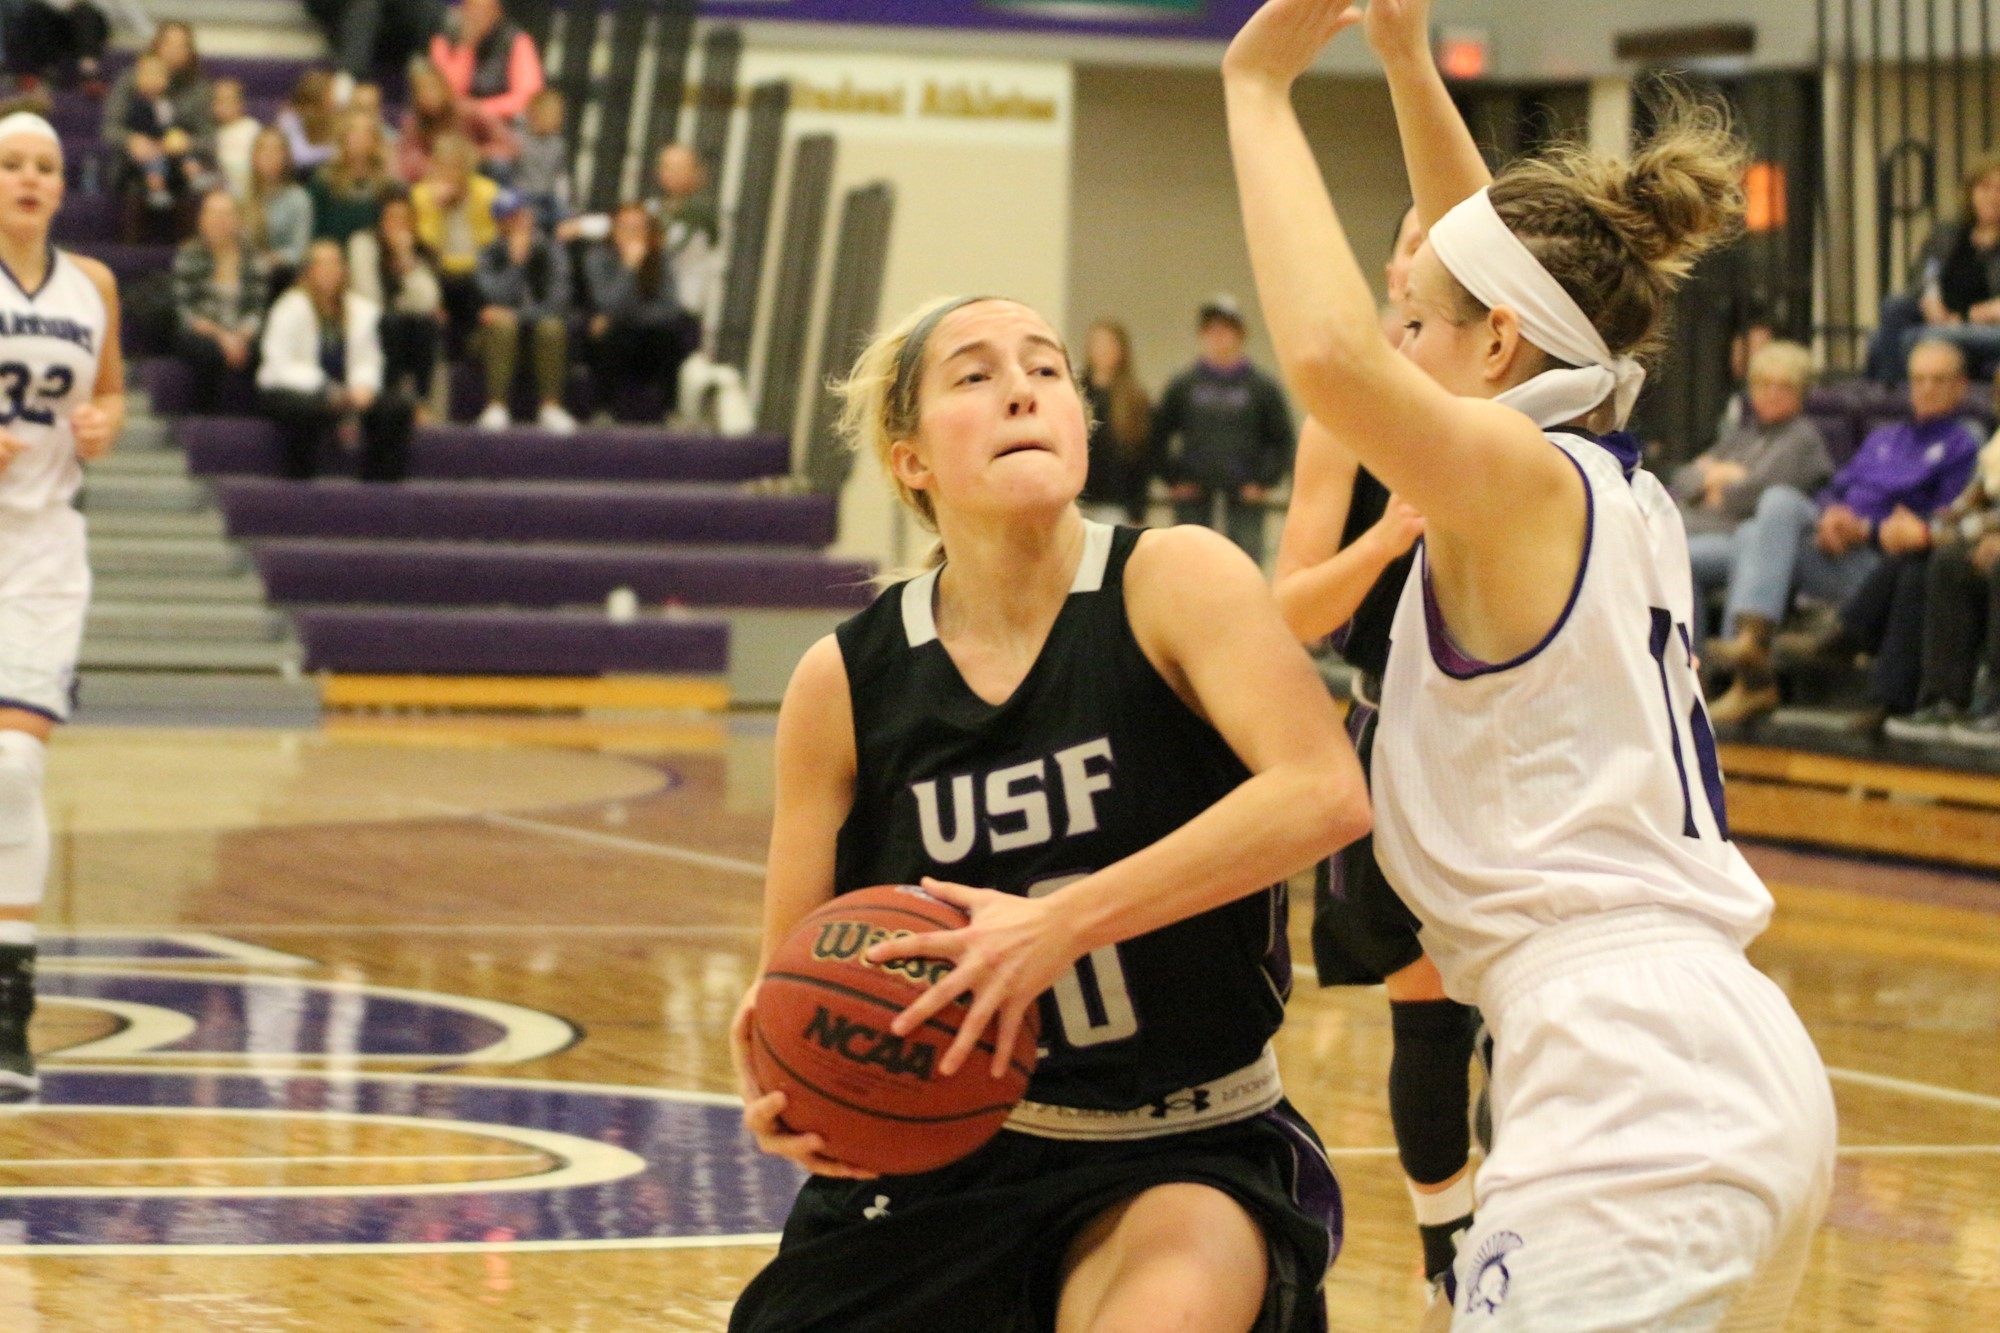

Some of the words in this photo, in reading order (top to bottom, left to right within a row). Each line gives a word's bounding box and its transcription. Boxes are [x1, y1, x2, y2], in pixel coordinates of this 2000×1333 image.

[0, 360, 74, 427] 32
[911, 737, 1115, 864] USF
[803, 1005, 937, 1081] NCAA
